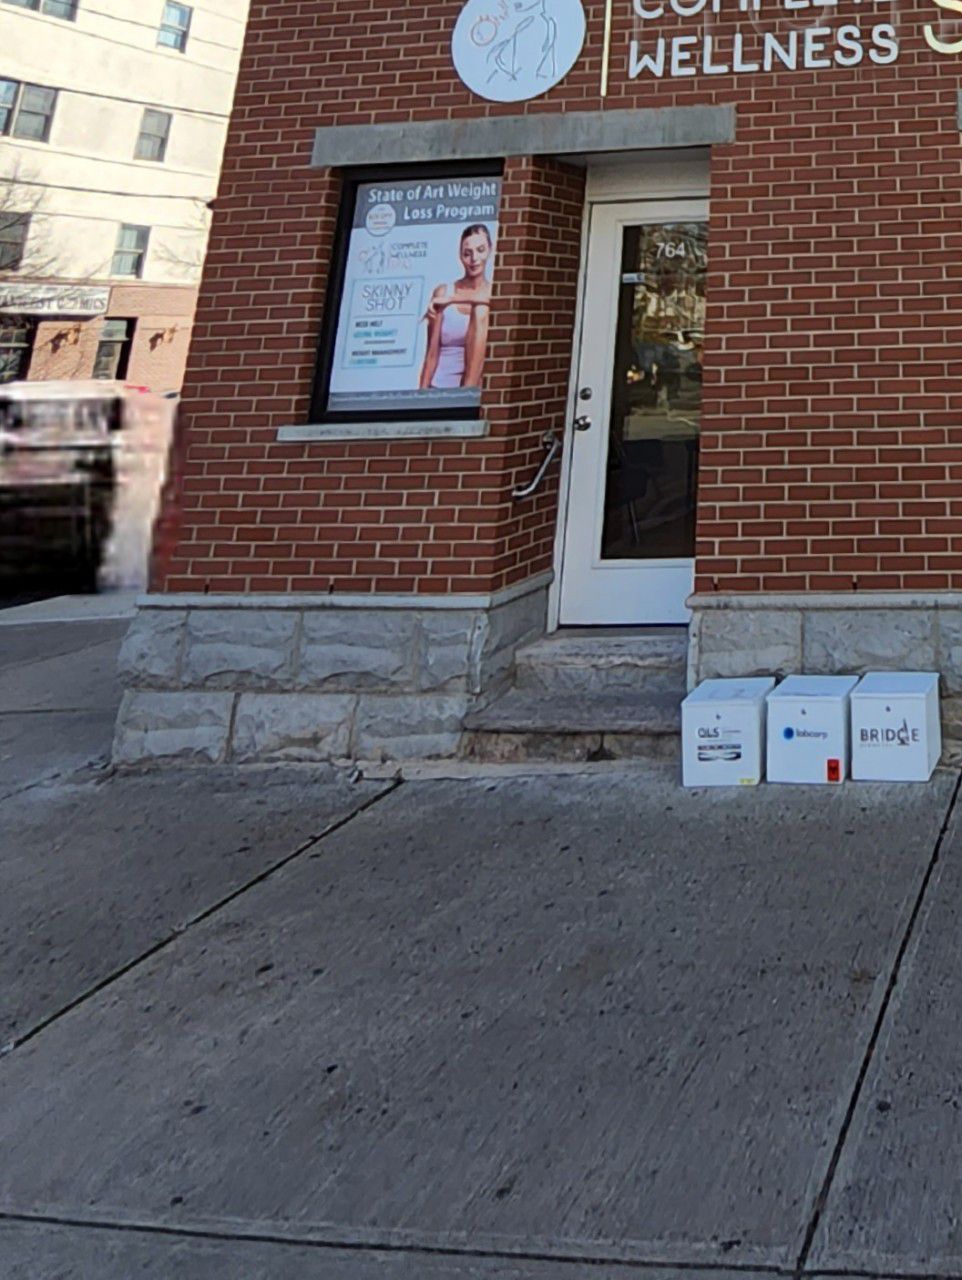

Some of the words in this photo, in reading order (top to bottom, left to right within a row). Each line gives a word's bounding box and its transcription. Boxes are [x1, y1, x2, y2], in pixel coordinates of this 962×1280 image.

[628, 23, 899, 79] WELLNESS
[368, 188, 403, 202] State
[407, 186, 421, 200] of
[423, 184, 444, 199] Art
[448, 182, 497, 200] Weight
[404, 206, 433, 220] Loss
[436, 204, 494, 220] Program
[656, 242, 685, 258] 764
[361, 282, 414, 298] SKINNY
[366, 296, 405, 312] SHOT
